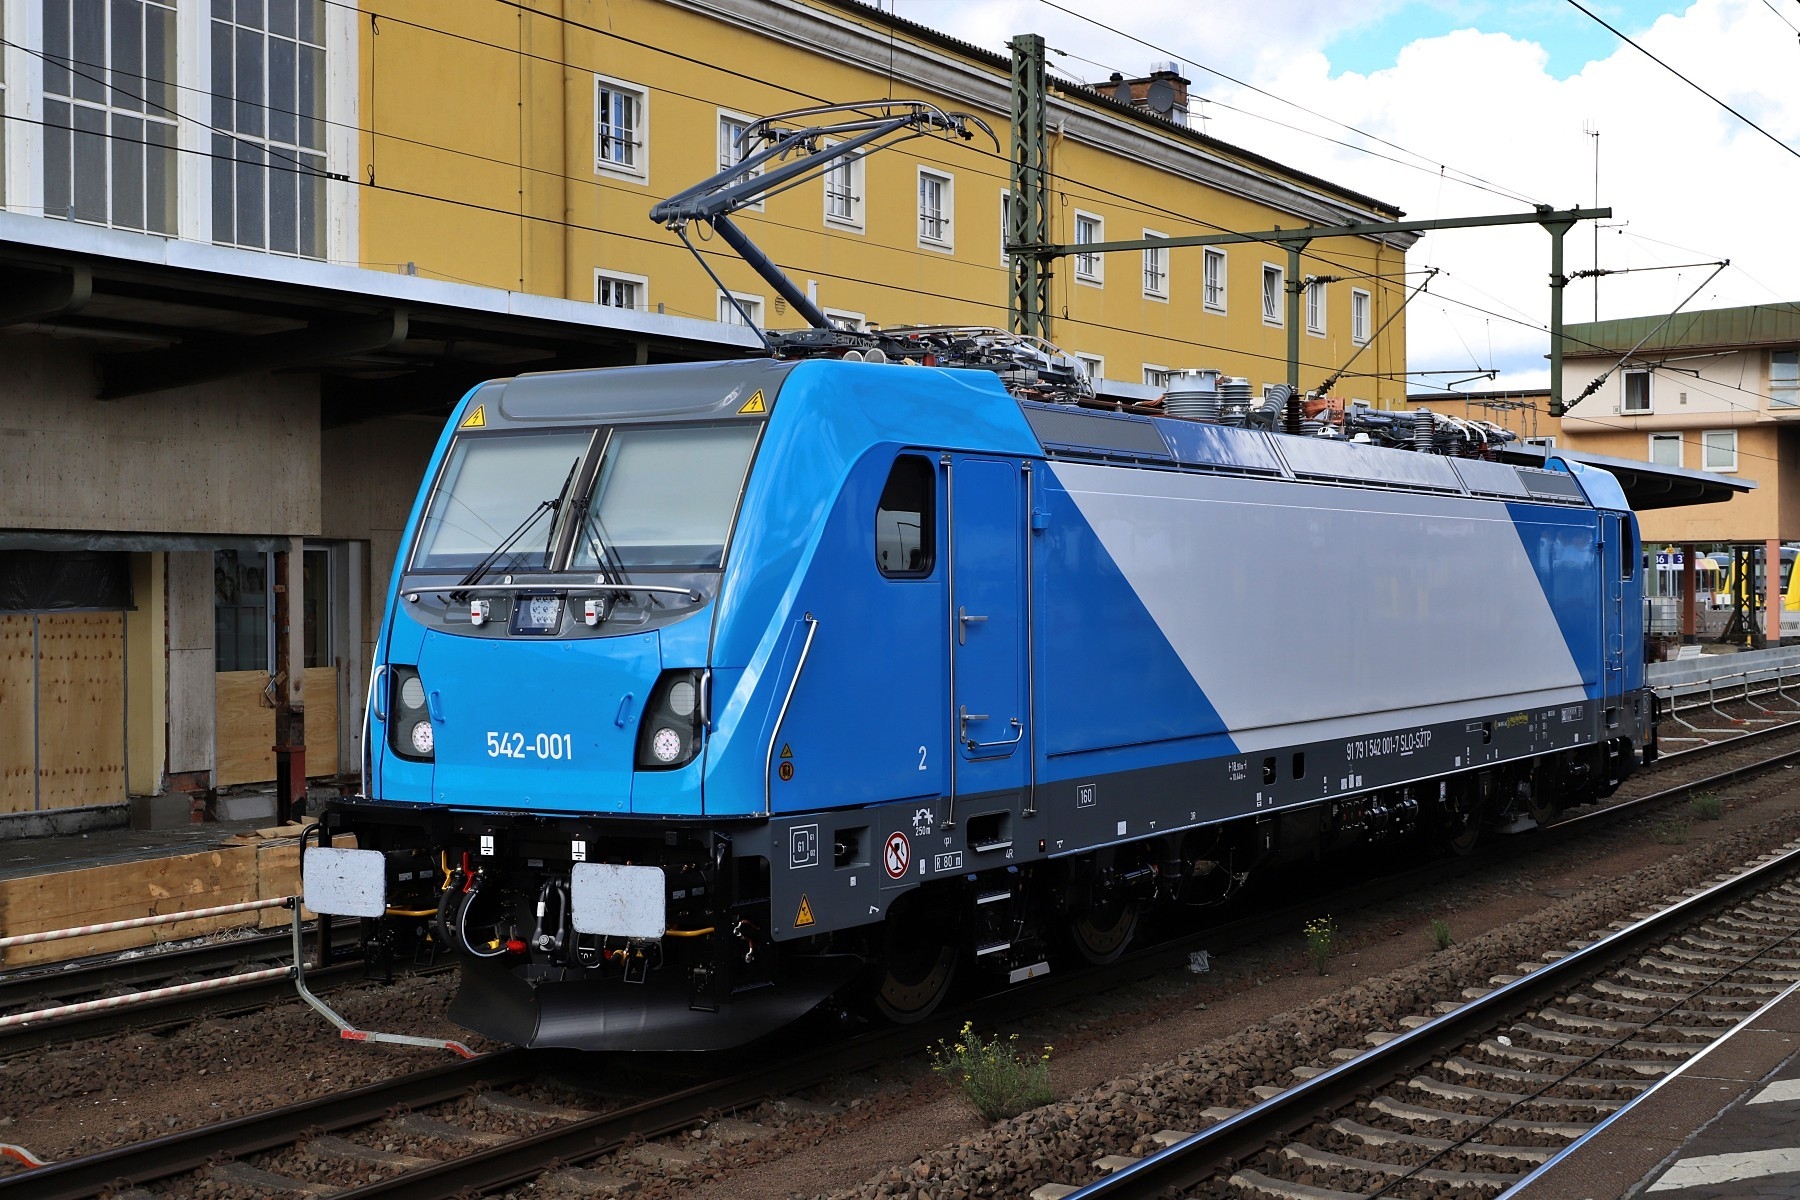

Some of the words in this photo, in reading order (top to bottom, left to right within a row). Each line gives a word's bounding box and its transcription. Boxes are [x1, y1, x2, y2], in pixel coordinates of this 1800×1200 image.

[486, 731, 572, 760] 542-001
[1346, 742, 1354, 761] 91
[1355, 741, 1364, 760] 79
[1369, 738, 1381, 757] 542
[1382, 735, 1399, 755] 001-7
[918, 745, 927, 771] 2
[1080, 788, 1092, 804] 160
[797, 840, 805, 853] G1
[936, 857, 941, 870] R
[943, 855, 953, 868] 80
